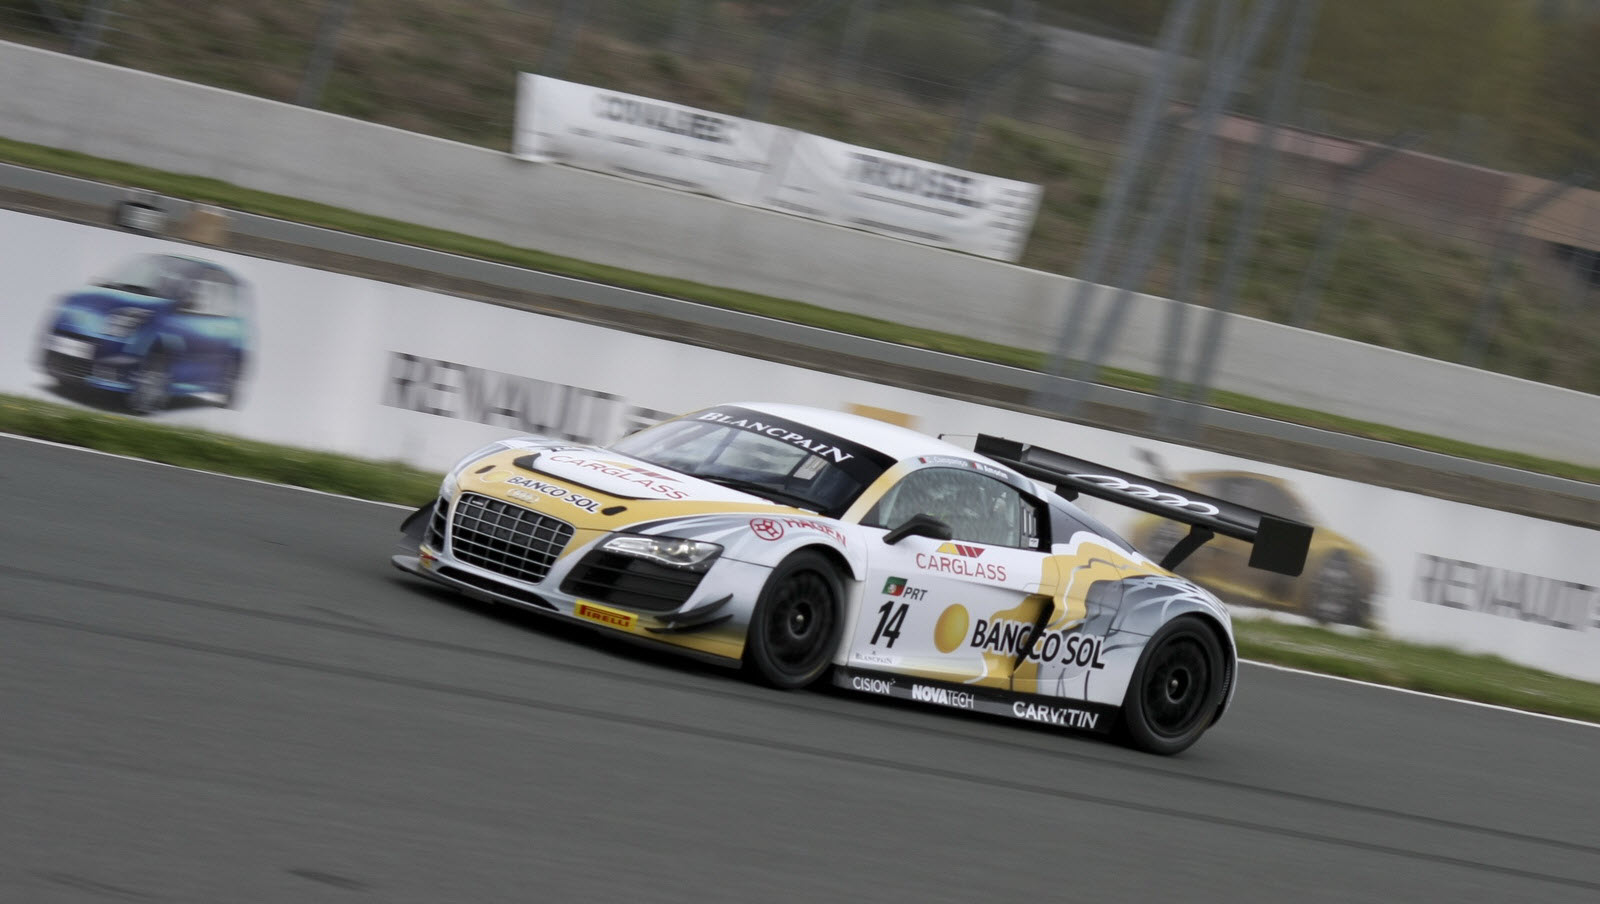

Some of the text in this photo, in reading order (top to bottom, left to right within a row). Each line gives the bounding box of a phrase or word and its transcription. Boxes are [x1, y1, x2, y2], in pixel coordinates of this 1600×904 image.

[697, 411, 855, 464] BLANCPAIN
[549, 454, 689, 500] CARGLASS
[507, 475, 601, 514] BANCO SOL
[782, 518, 848, 548] HAGEN
[915, 552, 1007, 582] CARGLASS
[902, 586, 928, 601] PRT
[579, 604, 631, 627] PIRELLI
[870, 600, 910, 649] 14
[1060, 634, 1107, 670] SOL
[852, 676, 890, 694] CISION
[911, 684, 975, 709] NOVATECH
